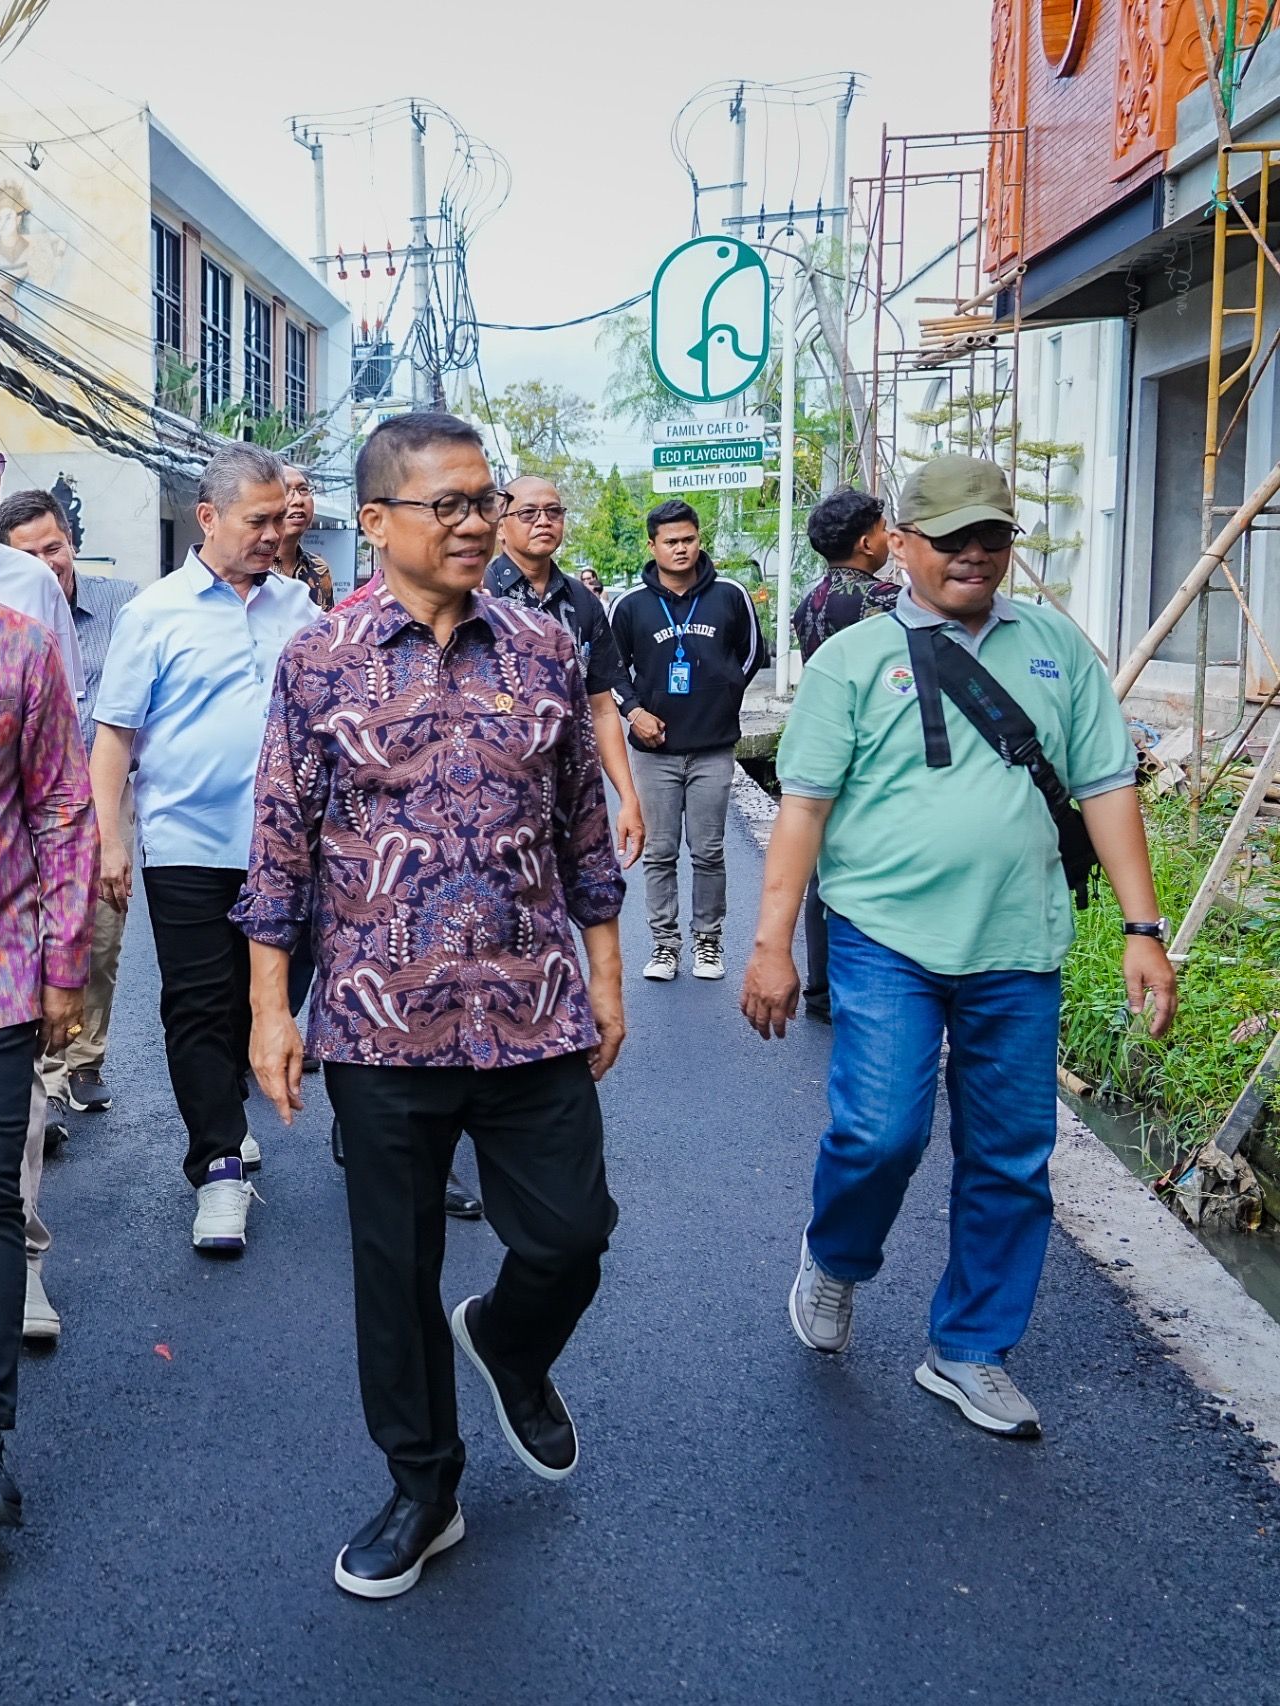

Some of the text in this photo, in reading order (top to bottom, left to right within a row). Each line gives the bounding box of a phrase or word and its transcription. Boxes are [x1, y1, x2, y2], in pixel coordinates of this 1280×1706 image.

[666, 424, 703, 437] FAMILY
[707, 422, 733, 435] CAFE
[660, 446, 756, 463] ECO PLAYGROUND
[669, 471, 747, 487] HEALTHY FOOD
